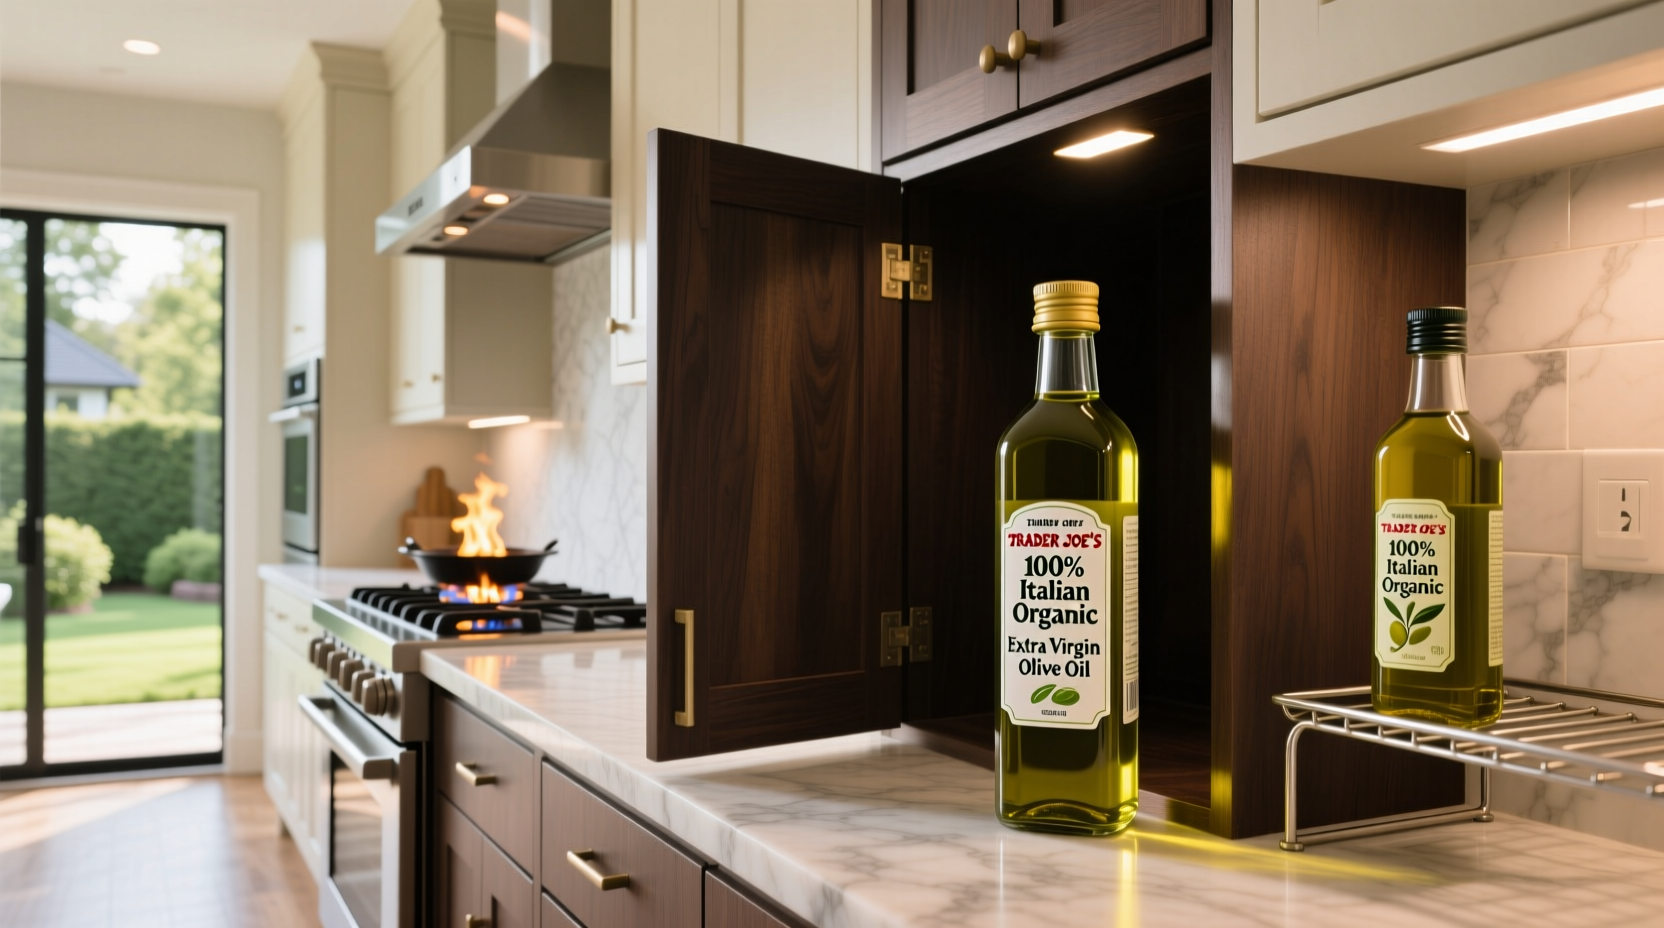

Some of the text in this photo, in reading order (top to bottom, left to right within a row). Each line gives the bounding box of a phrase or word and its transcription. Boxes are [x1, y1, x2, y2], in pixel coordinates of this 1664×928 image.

[1008, 532, 1102, 548] TRADER JOE'S
[1389, 539, 1435, 557] 100%
[1024, 555, 1084, 577] 100%
[1387, 558, 1438, 576] Italian
[1020, 579, 1089, 601] Italian
[1382, 577, 1444, 598] Organic
[1013, 602, 1098, 630] Organic
[1008, 636, 1100, 659] Extra Virgin
[1018, 658, 1090, 677] Olive Oil
